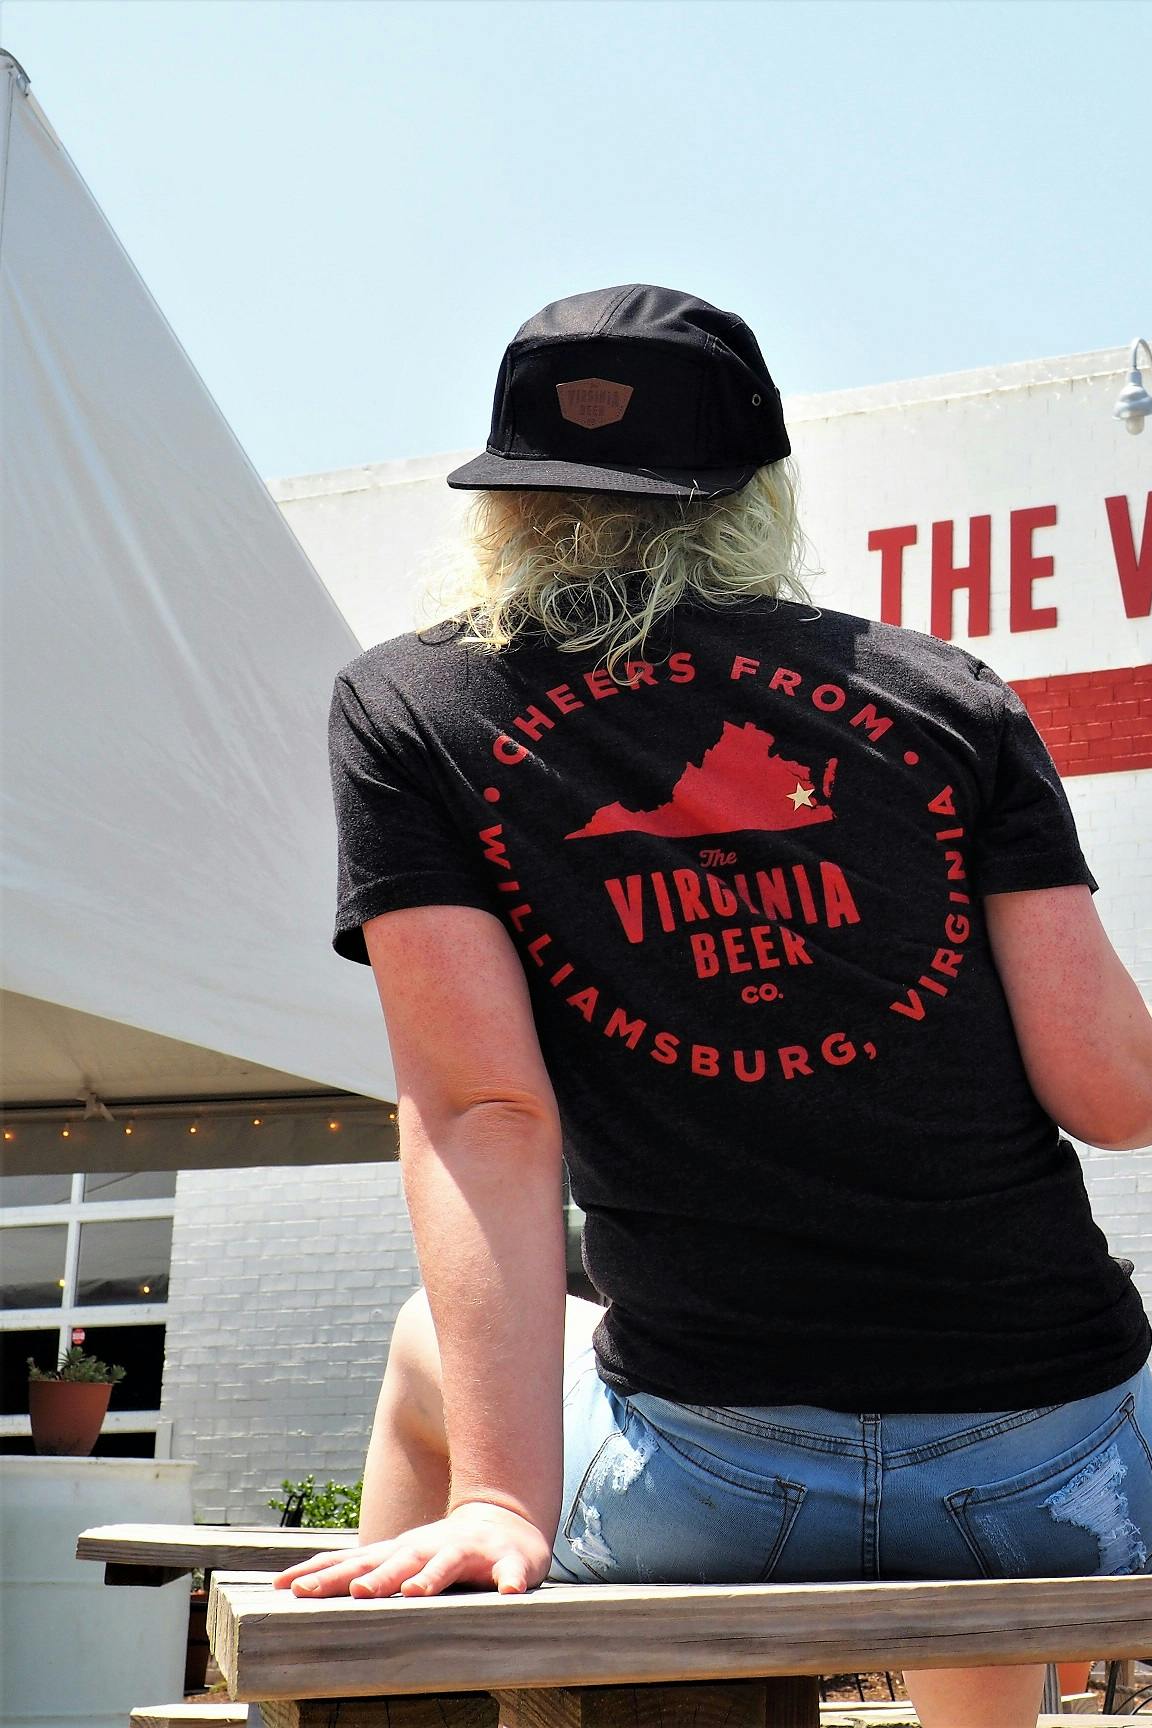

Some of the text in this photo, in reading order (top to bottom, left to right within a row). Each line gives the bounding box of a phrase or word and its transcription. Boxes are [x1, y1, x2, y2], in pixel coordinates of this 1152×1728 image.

[867, 504, 1058, 641] THE
[492, 652, 894, 765] CHEERS FROM
[700, 849, 738, 868] The
[479, 785, 971, 1082] WILLIAMSBURG, VIRGINIA
[604, 861, 861, 944] VIRGINIA
[690, 925, 814, 979] BEER
[741, 983, 784, 1004] CO.
